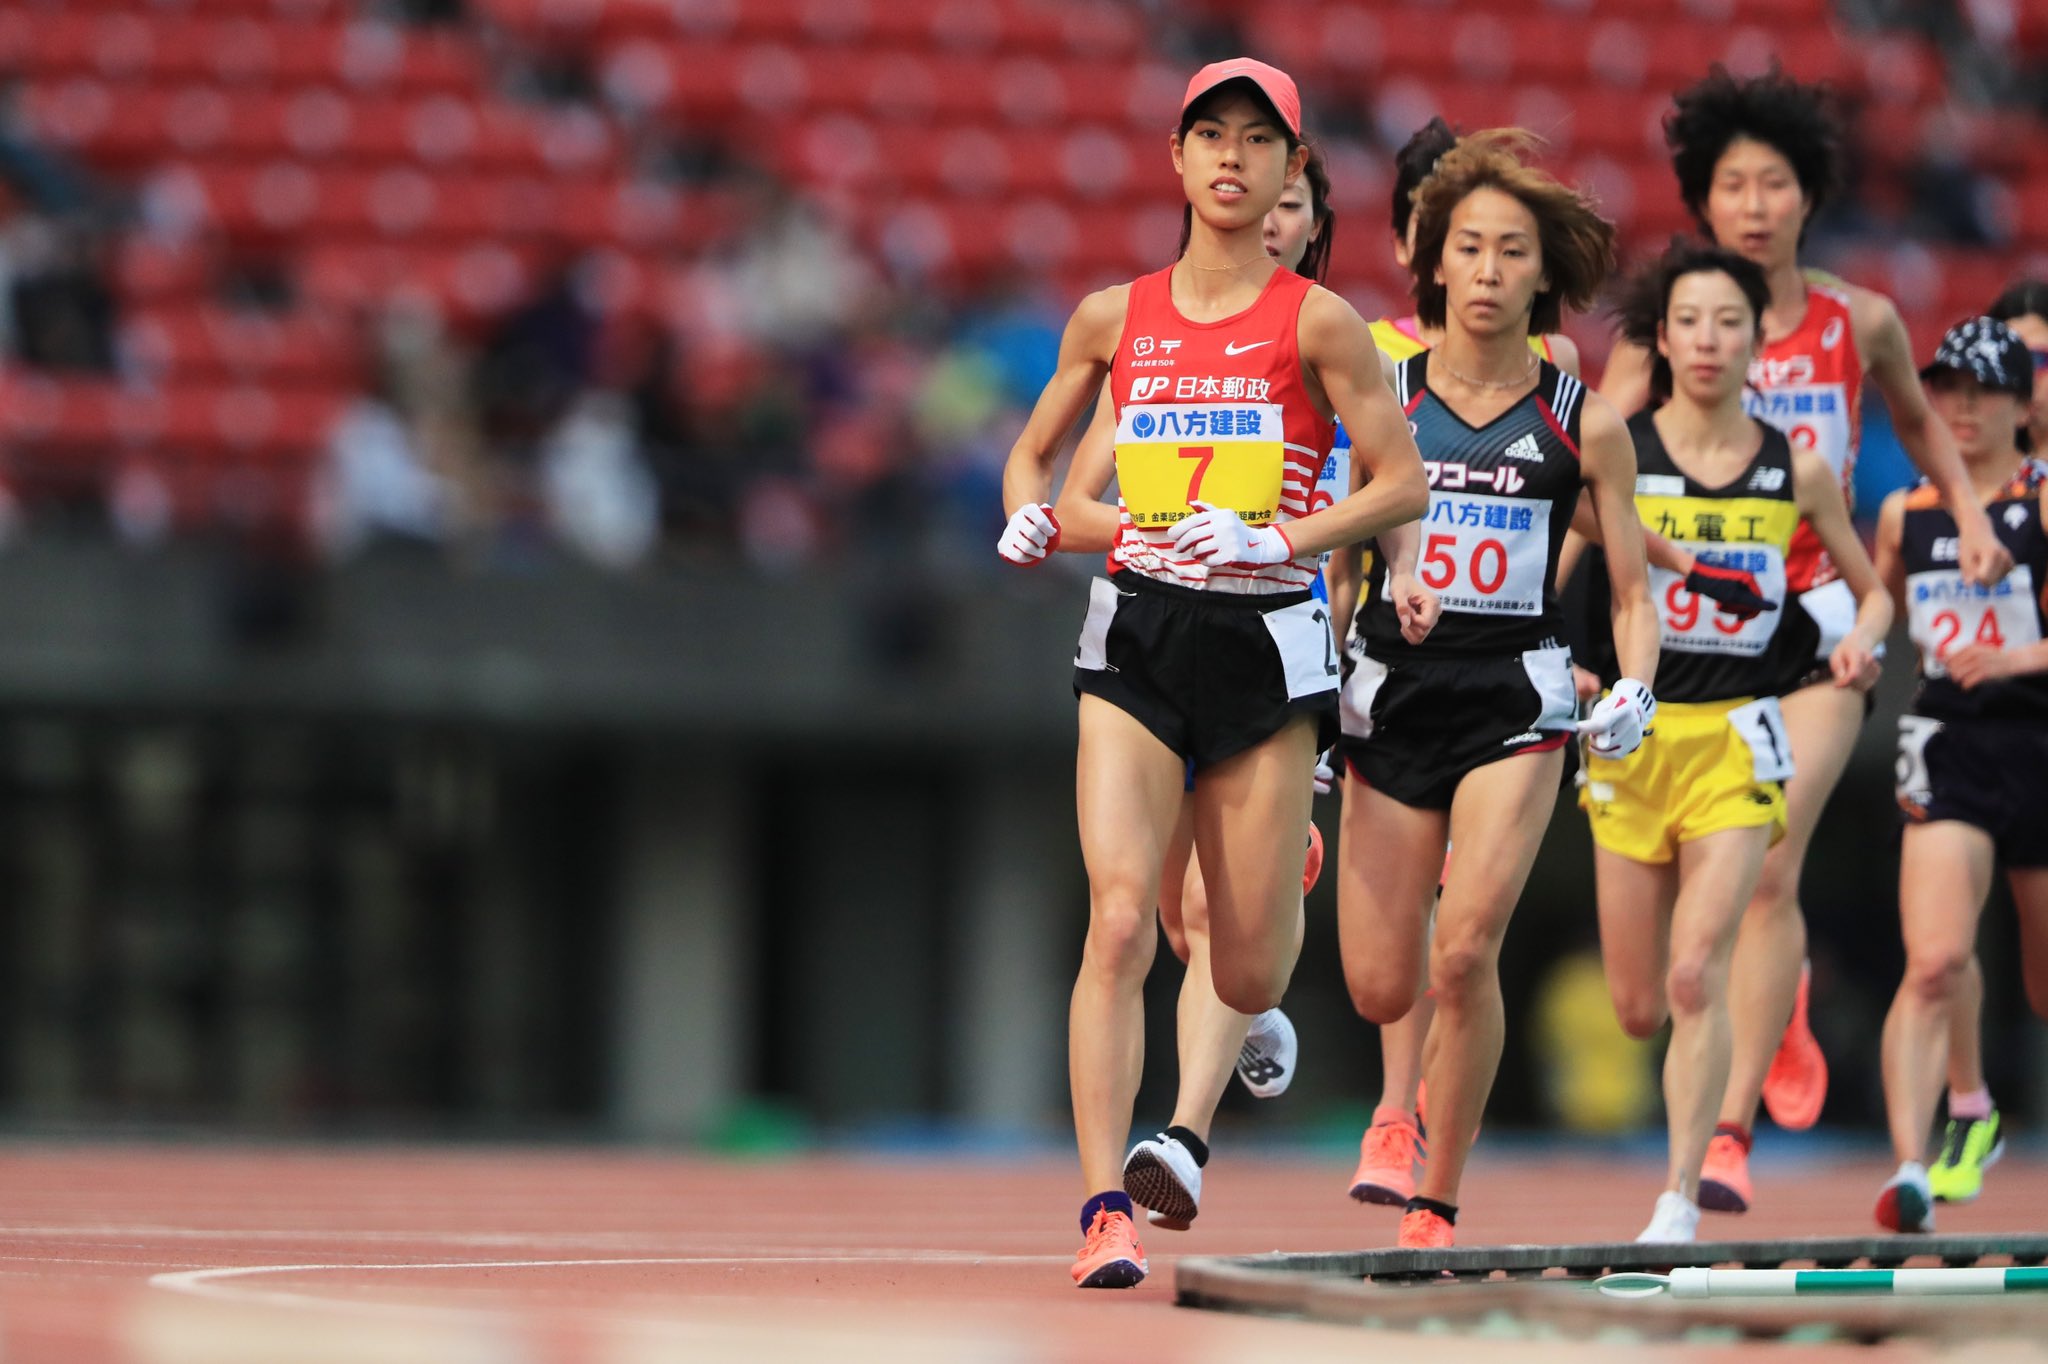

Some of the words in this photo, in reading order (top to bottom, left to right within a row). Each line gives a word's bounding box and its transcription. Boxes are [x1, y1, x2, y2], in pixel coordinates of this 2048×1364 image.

[1129, 376, 1170, 402] JP
[1175, 375, 1271, 400] 日本郵政
[1158, 409, 1262, 436] 八方建設
[1504, 447, 1545, 463] adidas
[1177, 446, 1214, 506] 7
[1235, 510, 1272, 521] 距離大会
[1431, 500, 1534, 531] 八方建設
[1655, 510, 1767, 542] 九電工
[1421, 533, 1508, 594] 50
[1931, 606, 2005, 662] 24
